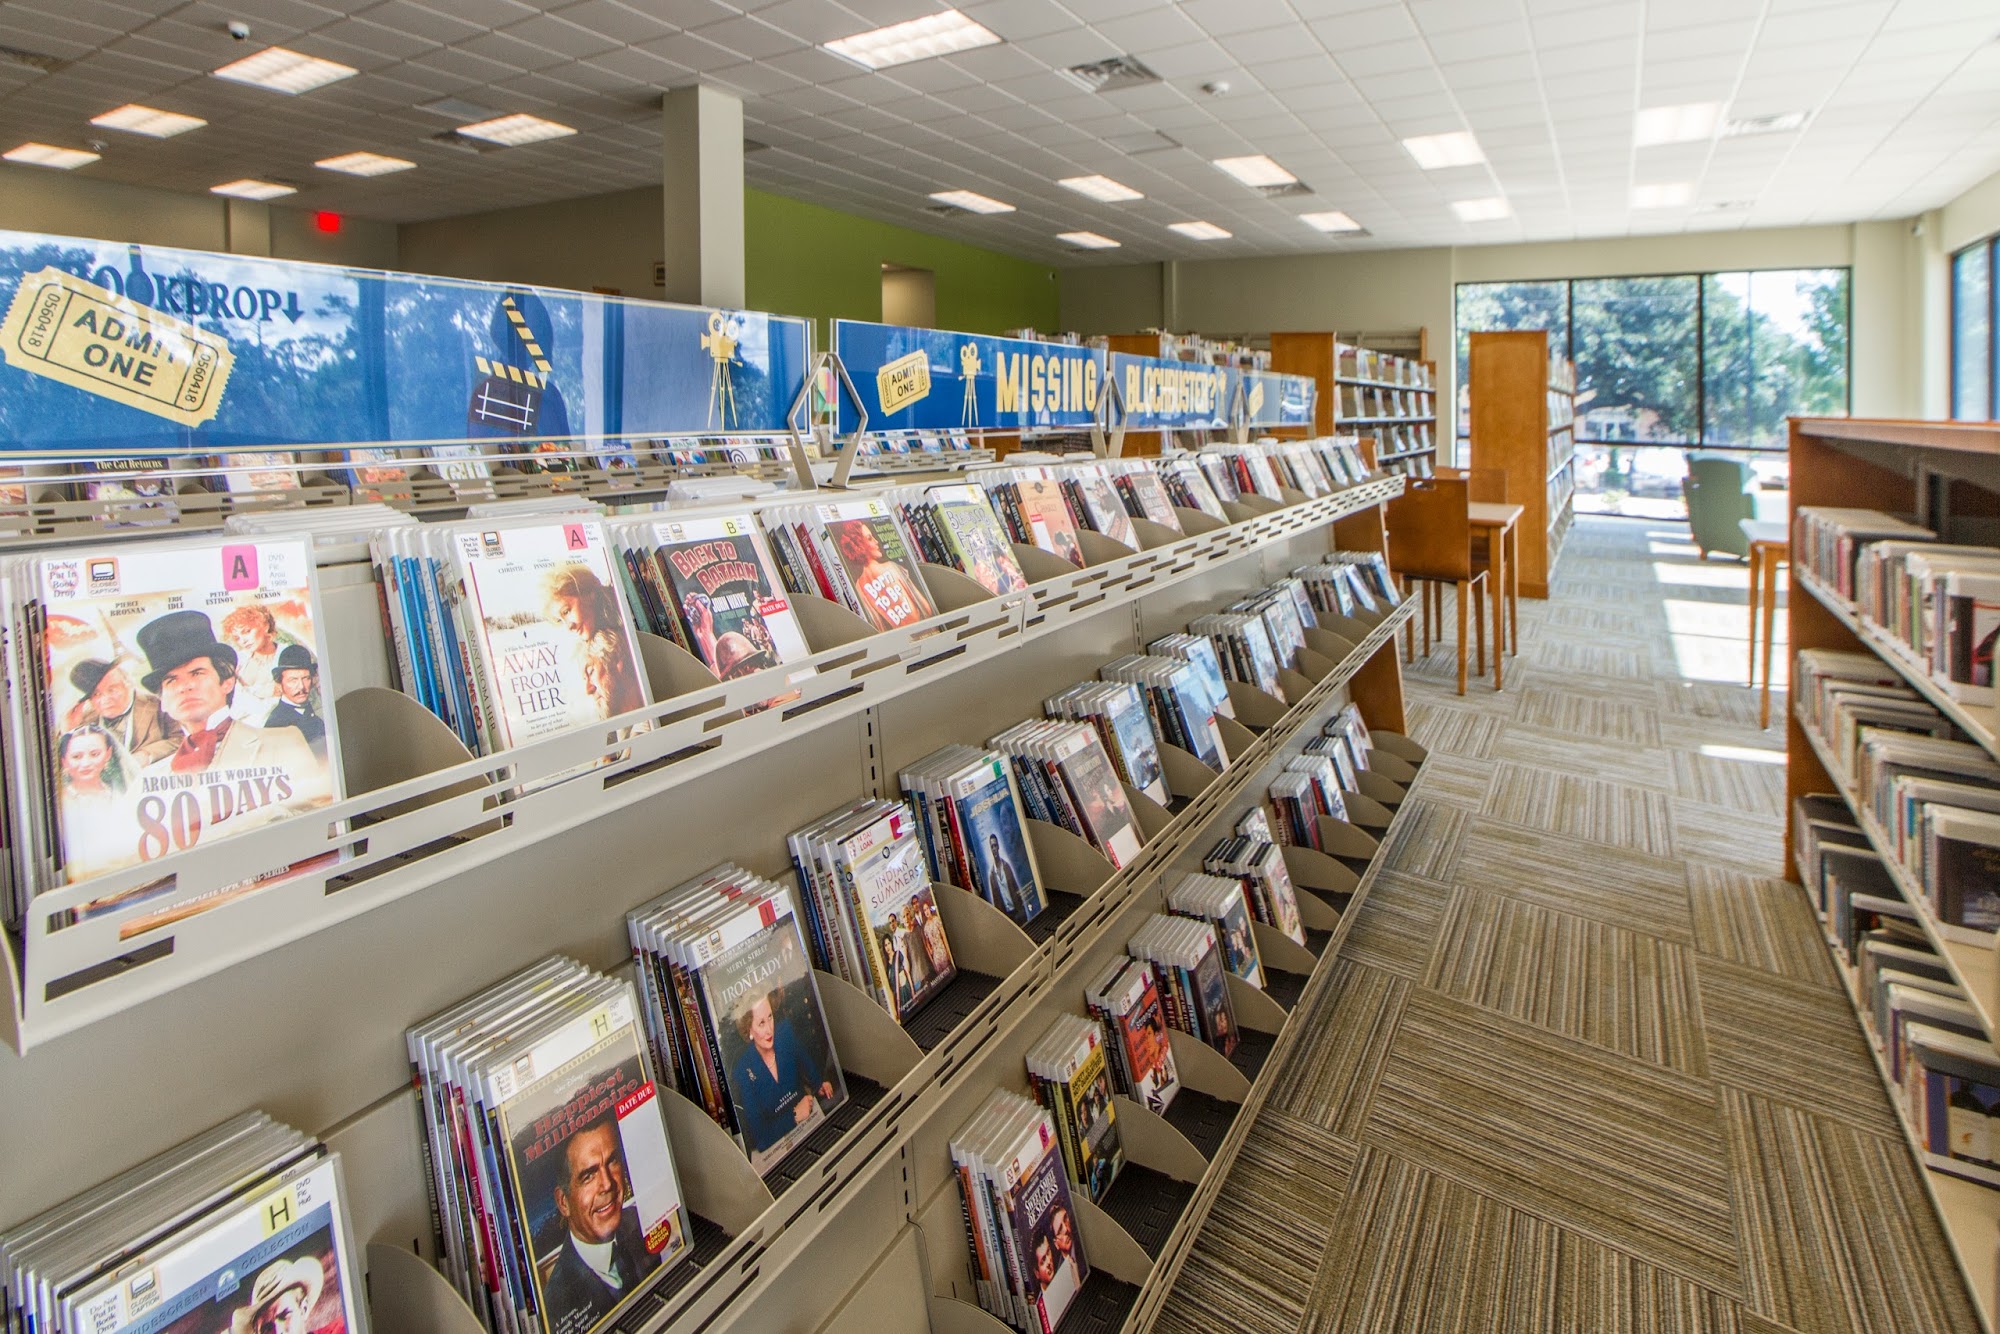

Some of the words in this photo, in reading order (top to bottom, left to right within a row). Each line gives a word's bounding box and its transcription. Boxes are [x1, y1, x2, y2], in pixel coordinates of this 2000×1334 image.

[73, 308, 176, 365] ADMIT
[83, 344, 158, 387] ONE
[892, 364, 916, 386] ADMIT
[897, 380, 915, 397] ONE
[996, 351, 1097, 413] MISSING
[96, 459, 112, 470] The
[113, 459, 129, 470] Cat
[129, 458, 163, 470] Returns
[868, 503, 878, 515] B
[571, 529, 584, 547] A
[726, 521, 737, 535] B
[231, 554, 249, 580] A
[669, 543, 720, 580] BACK
[713, 541, 738, 561] TO
[696, 561, 759, 596] BATAAN
[863, 570, 895, 600] Born
[875, 594, 891, 612] To
[885, 584, 903, 601] Be
[886, 596, 913, 626] Bad
[503, 644, 559, 676] AWAY
[469, 629, 481, 661] AWAY
[477, 664, 488, 701] FROM
[486, 705, 496, 731] HER
[510, 668, 562, 694] FROM
[517, 687, 568, 716] HER
[473, 705, 482, 731] GO
[142, 774, 193, 794] AROUND
[198, 771, 222, 786] THE
[224, 767, 270, 784] WORLD
[270, 765, 284, 777] IN
[1027, 755, 1039, 775] KING
[1037, 776, 1050, 799] KINGS
[137, 790, 201, 863] 80
[207, 774, 294, 826] DAYS
[860, 839, 874, 852] LOAN
[871, 864, 919, 909] SUMMERS
[855, 903, 871, 946] INDIAN
[726, 958, 746, 976] MERYL
[747, 943, 768, 963] STREEP
[745, 963, 755, 973] THE
[721, 973, 753, 1005] IRON
[752, 955, 782, 985] LADY
[594, 1013, 609, 1037] H
[709, 1043, 719, 1067] IRON
[717, 1067, 726, 1093] LADY
[534, 1067, 624, 1138] Happiest
[618, 1094, 641, 1114] DATE
[636, 1085, 653, 1102] DUE
[523, 1077, 639, 1160] Millionaire
[296, 1177, 311, 1191] DVD
[296, 1188, 307, 1199] Fic
[269, 1197, 290, 1231] H
[298, 1195, 312, 1207] Hud
[647, 1226, 668, 1246] LONGER
[648, 1231, 670, 1251] VERSION
[649, 1223, 663, 1237] NEW
[241, 1222, 309, 1271] COLLECTION
[89, 1304, 103, 1315] Do
[103, 1294, 118, 1307] Not
[93, 1310, 106, 1321] Put
[107, 1304, 117, 1313] In
[130, 1289, 157, 1309] CLOSED
[130, 1295, 160, 1317] CAPTION
[95, 1312, 116, 1329] Book
[96, 1319, 118, 1334] Drop
